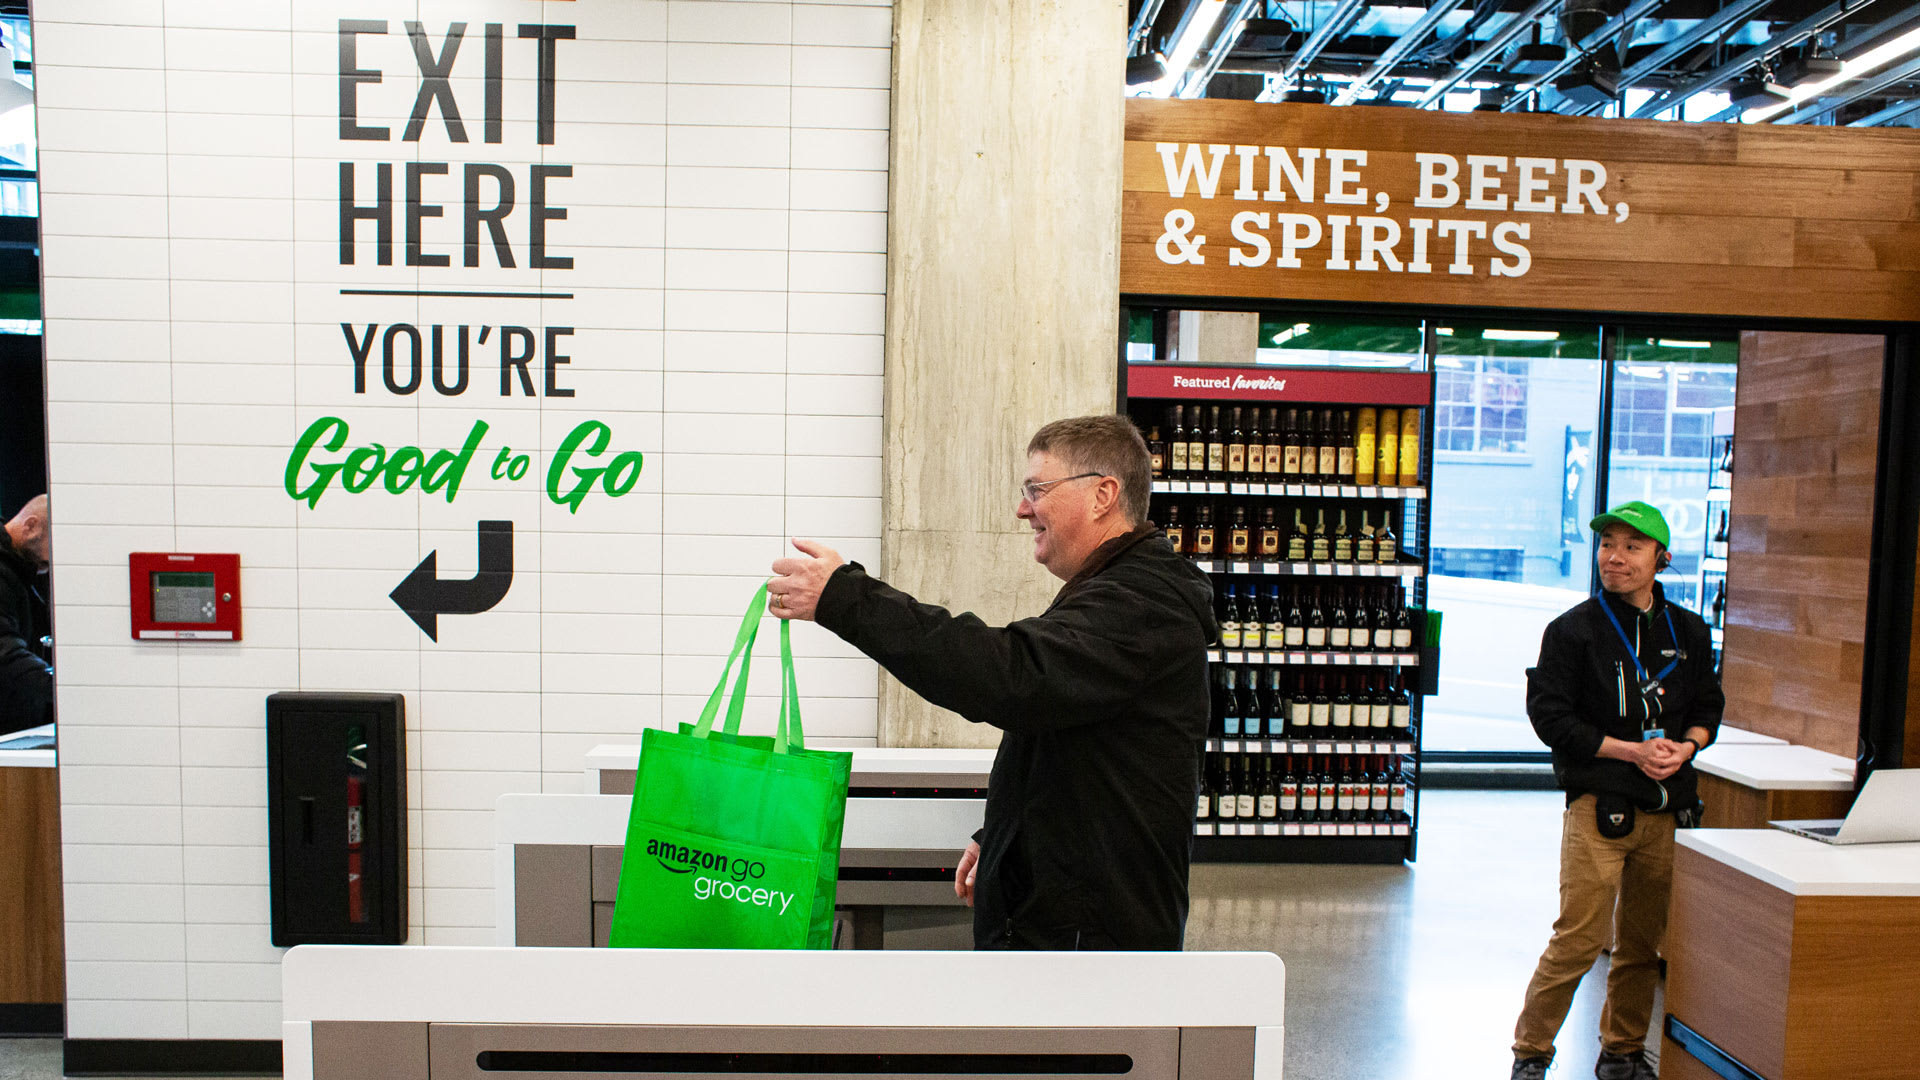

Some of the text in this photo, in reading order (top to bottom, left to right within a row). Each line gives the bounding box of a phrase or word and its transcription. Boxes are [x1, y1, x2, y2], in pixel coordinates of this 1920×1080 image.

[339, 19, 577, 146] EXIT
[339, 162, 574, 270] HERE
[1156, 142, 1631, 224] WINE, BEER,
[1155, 208, 1533, 278] & SPIRITS
[340, 322, 576, 398] YOU'RE
[1173, 374, 1287, 391] Featured favorites
[284, 416, 643, 514] Good to Go
[646, 838, 766, 882] amazon go
[694, 876, 794, 916] grocery
